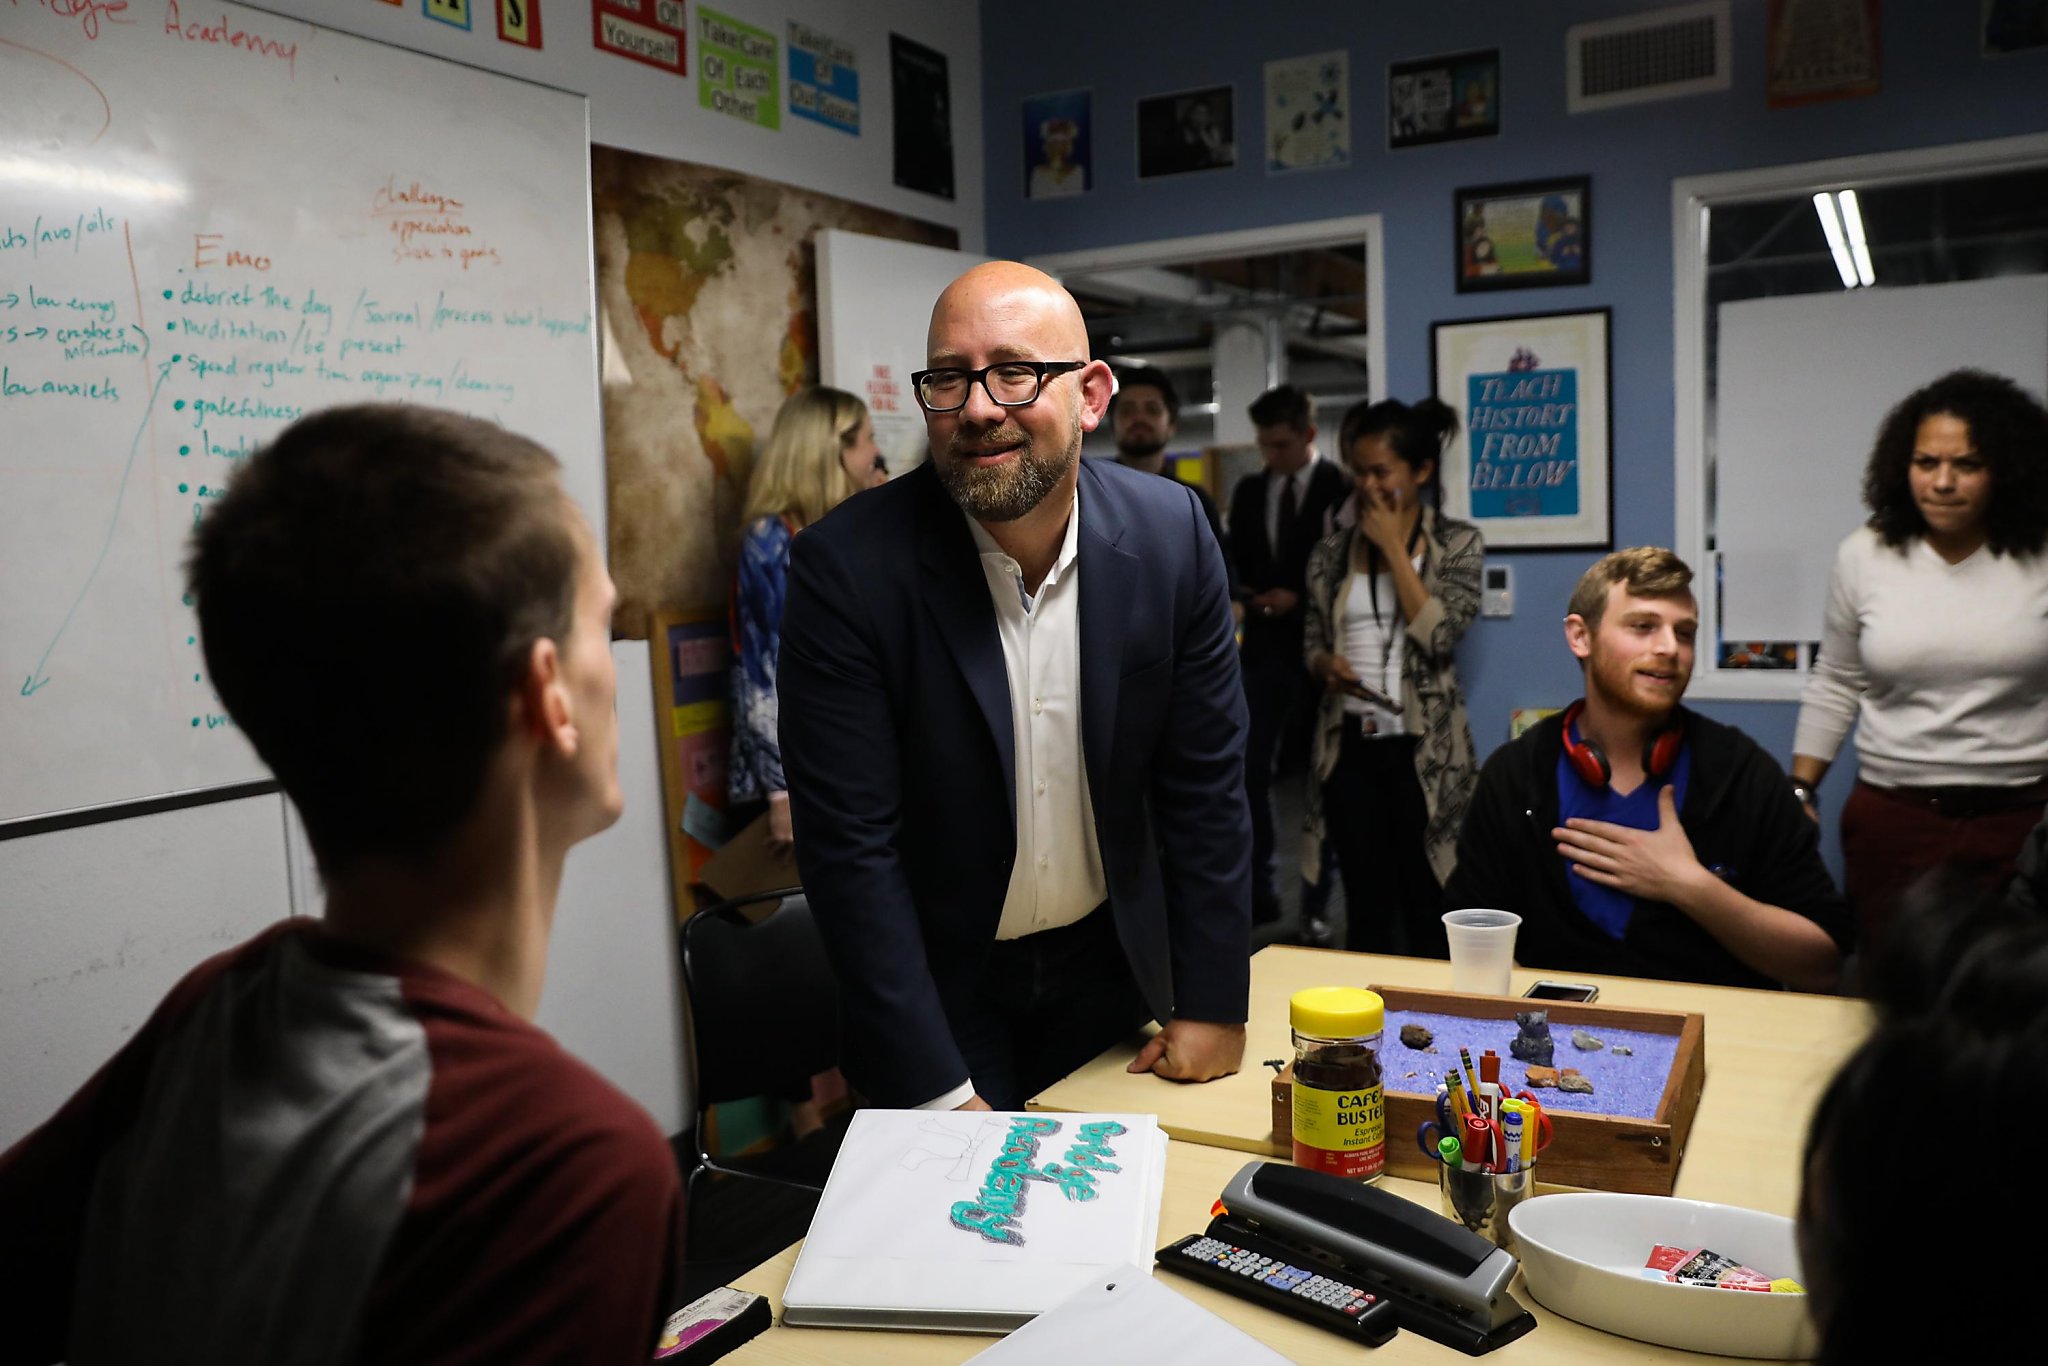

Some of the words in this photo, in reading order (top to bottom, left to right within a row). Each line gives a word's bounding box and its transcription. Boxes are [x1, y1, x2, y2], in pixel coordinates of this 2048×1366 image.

[165, 0, 297, 80] Academy
[604, 20, 677, 63] Yourself
[702, 17, 738, 48] Take
[739, 33, 774, 60] Care
[703, 55, 725, 81] Of
[735, 65, 770, 93] Each
[711, 89, 756, 119] Other
[1481, 374, 1563, 402] TEACH
[1470, 402, 1575, 430] HISTORY
[1481, 431, 1562, 460] FROM
[1471, 459, 1578, 490] BELOW
[1337, 1104, 1385, 1126] BUSTEL
[1343, 1136, 1371, 1147] Instant
